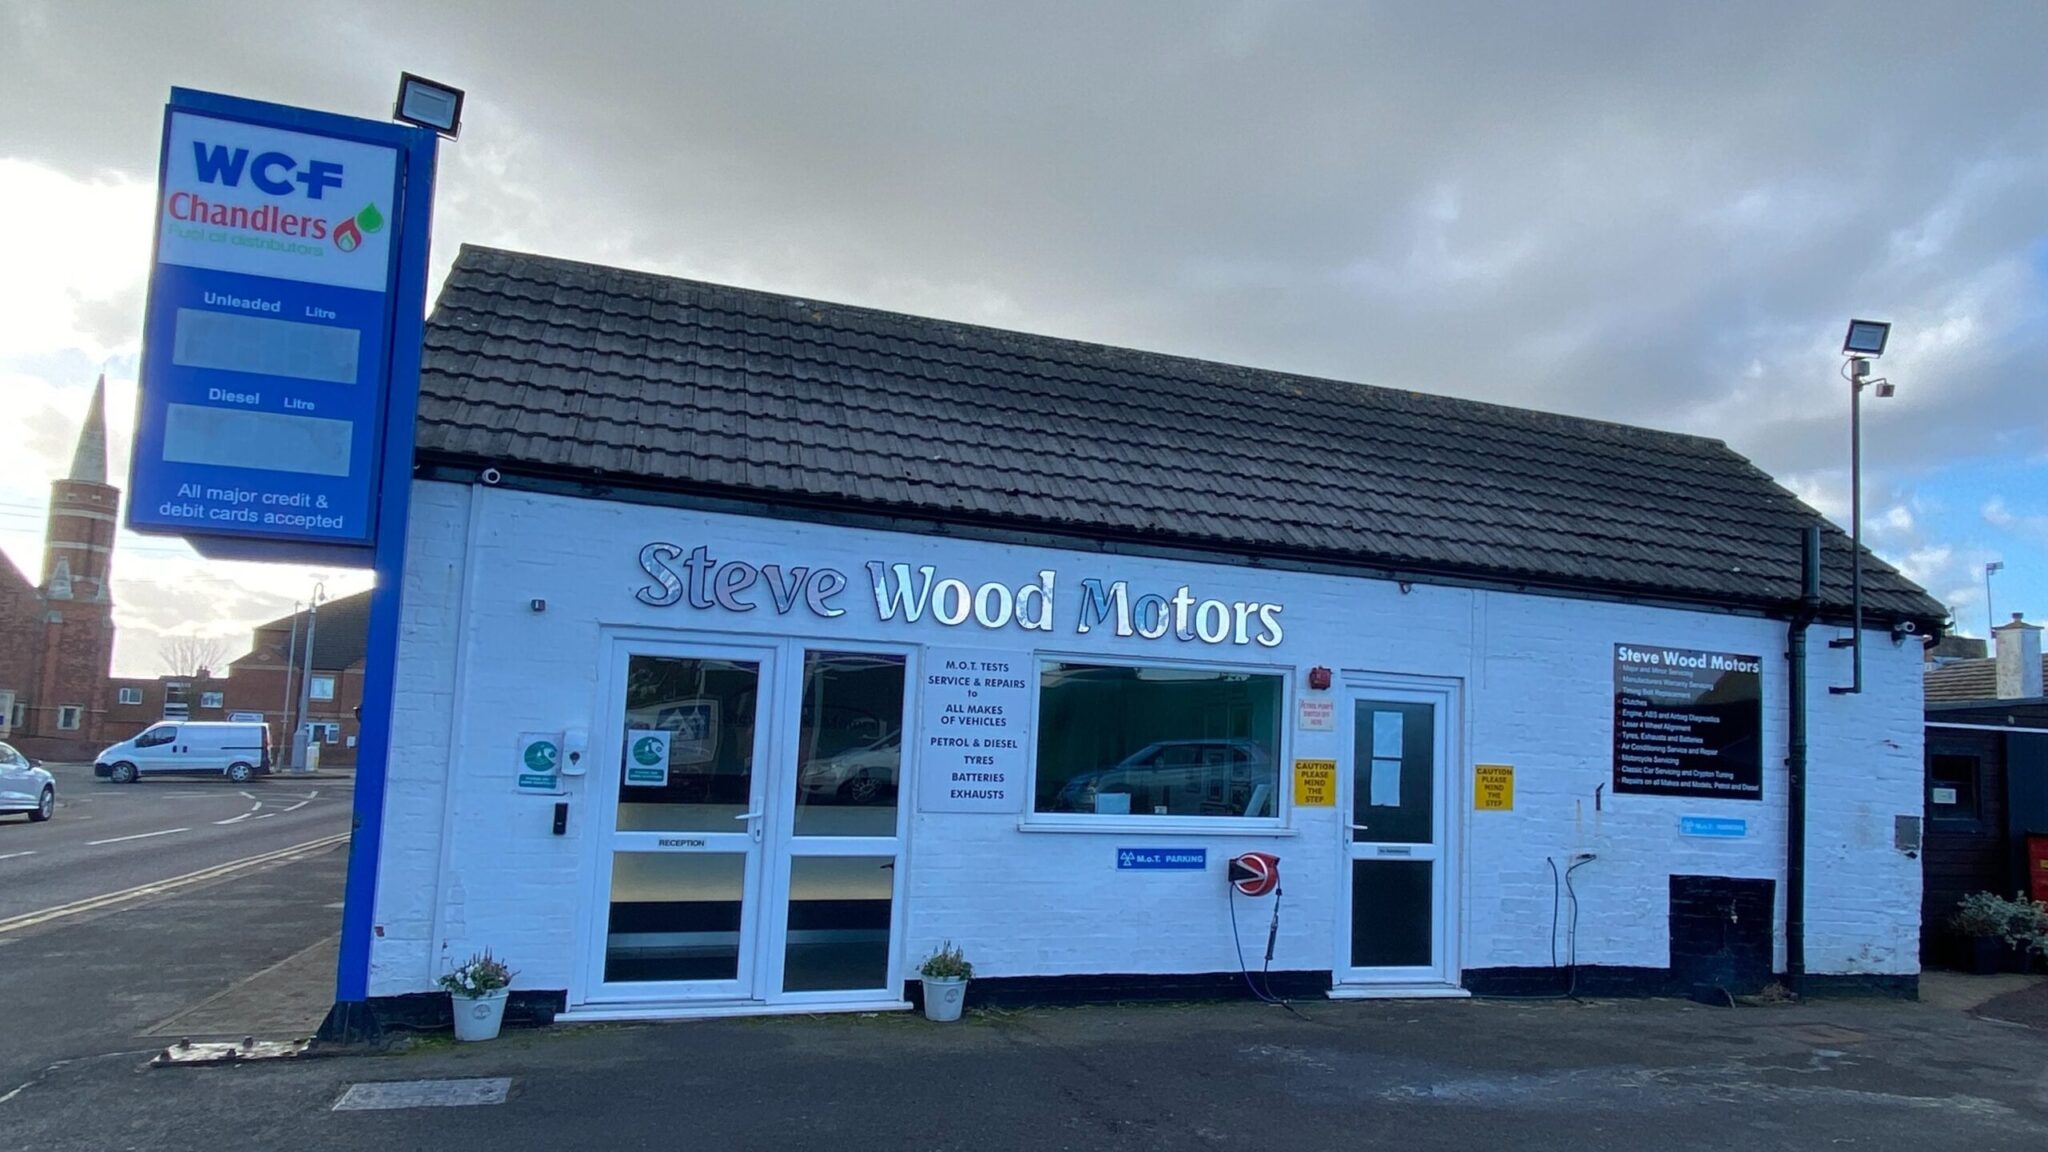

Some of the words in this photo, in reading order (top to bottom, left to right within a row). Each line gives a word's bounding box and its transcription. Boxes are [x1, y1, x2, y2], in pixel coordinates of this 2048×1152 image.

[193, 141, 343, 200] WCF
[168, 192, 327, 240] Chandlers
[168, 224, 205, 241] Fuel
[208, 231, 226, 242] oil
[231, 234, 324, 257] distributors
[204, 292, 281, 313] Unleaded
[305, 306, 336, 319] Litre
[209, 388, 260, 405] Diesel
[284, 397, 315, 411] Litre
[178, 483, 201, 499] All
[207, 488, 257, 505] major
[262, 491, 311, 508] credit
[316, 495, 328, 509] &
[159, 502, 204, 519] debit
[209, 505, 258, 523] cards
[264, 511, 343, 529] accepted
[635, 542, 847, 618] Steve
[865, 561, 1056, 631] Wood
[1076, 578, 1284, 648] Motors
[1618, 647, 1660, 665] Steve
[1663, 651, 1706, 669] Wood
[1711, 655, 1759, 673] Motors
[946, 661, 977, 671] M.O.T.
[981, 662, 1010, 672] TESTS
[928, 675, 970, 686] SERVICE
[974, 678, 981, 687] &
[985, 678, 1026, 688] REPAIRS
[968, 689, 978, 698] to
[946, 704, 964, 713] ALL
[967, 705, 1003, 715] MAKES
[941, 716, 955, 725] OF
[958, 716, 1007, 726] VEHICLES
[930, 737, 969, 747] PETROL
[973, 738, 980, 747] &
[984, 739, 1018, 749] DIESEL
[964, 755, 994, 765] TYRES
[1296, 762, 1335, 770] CAUTION
[952, 772, 1005, 782] BATTERIES
[1476, 768, 1512, 776] CAUTION
[1484, 783, 1505, 791] MIND
[950, 789, 1004, 799] EXHAUSTS
[658, 839, 705, 847] RECEPTION
[1166, 855, 1203, 863] PARKING
